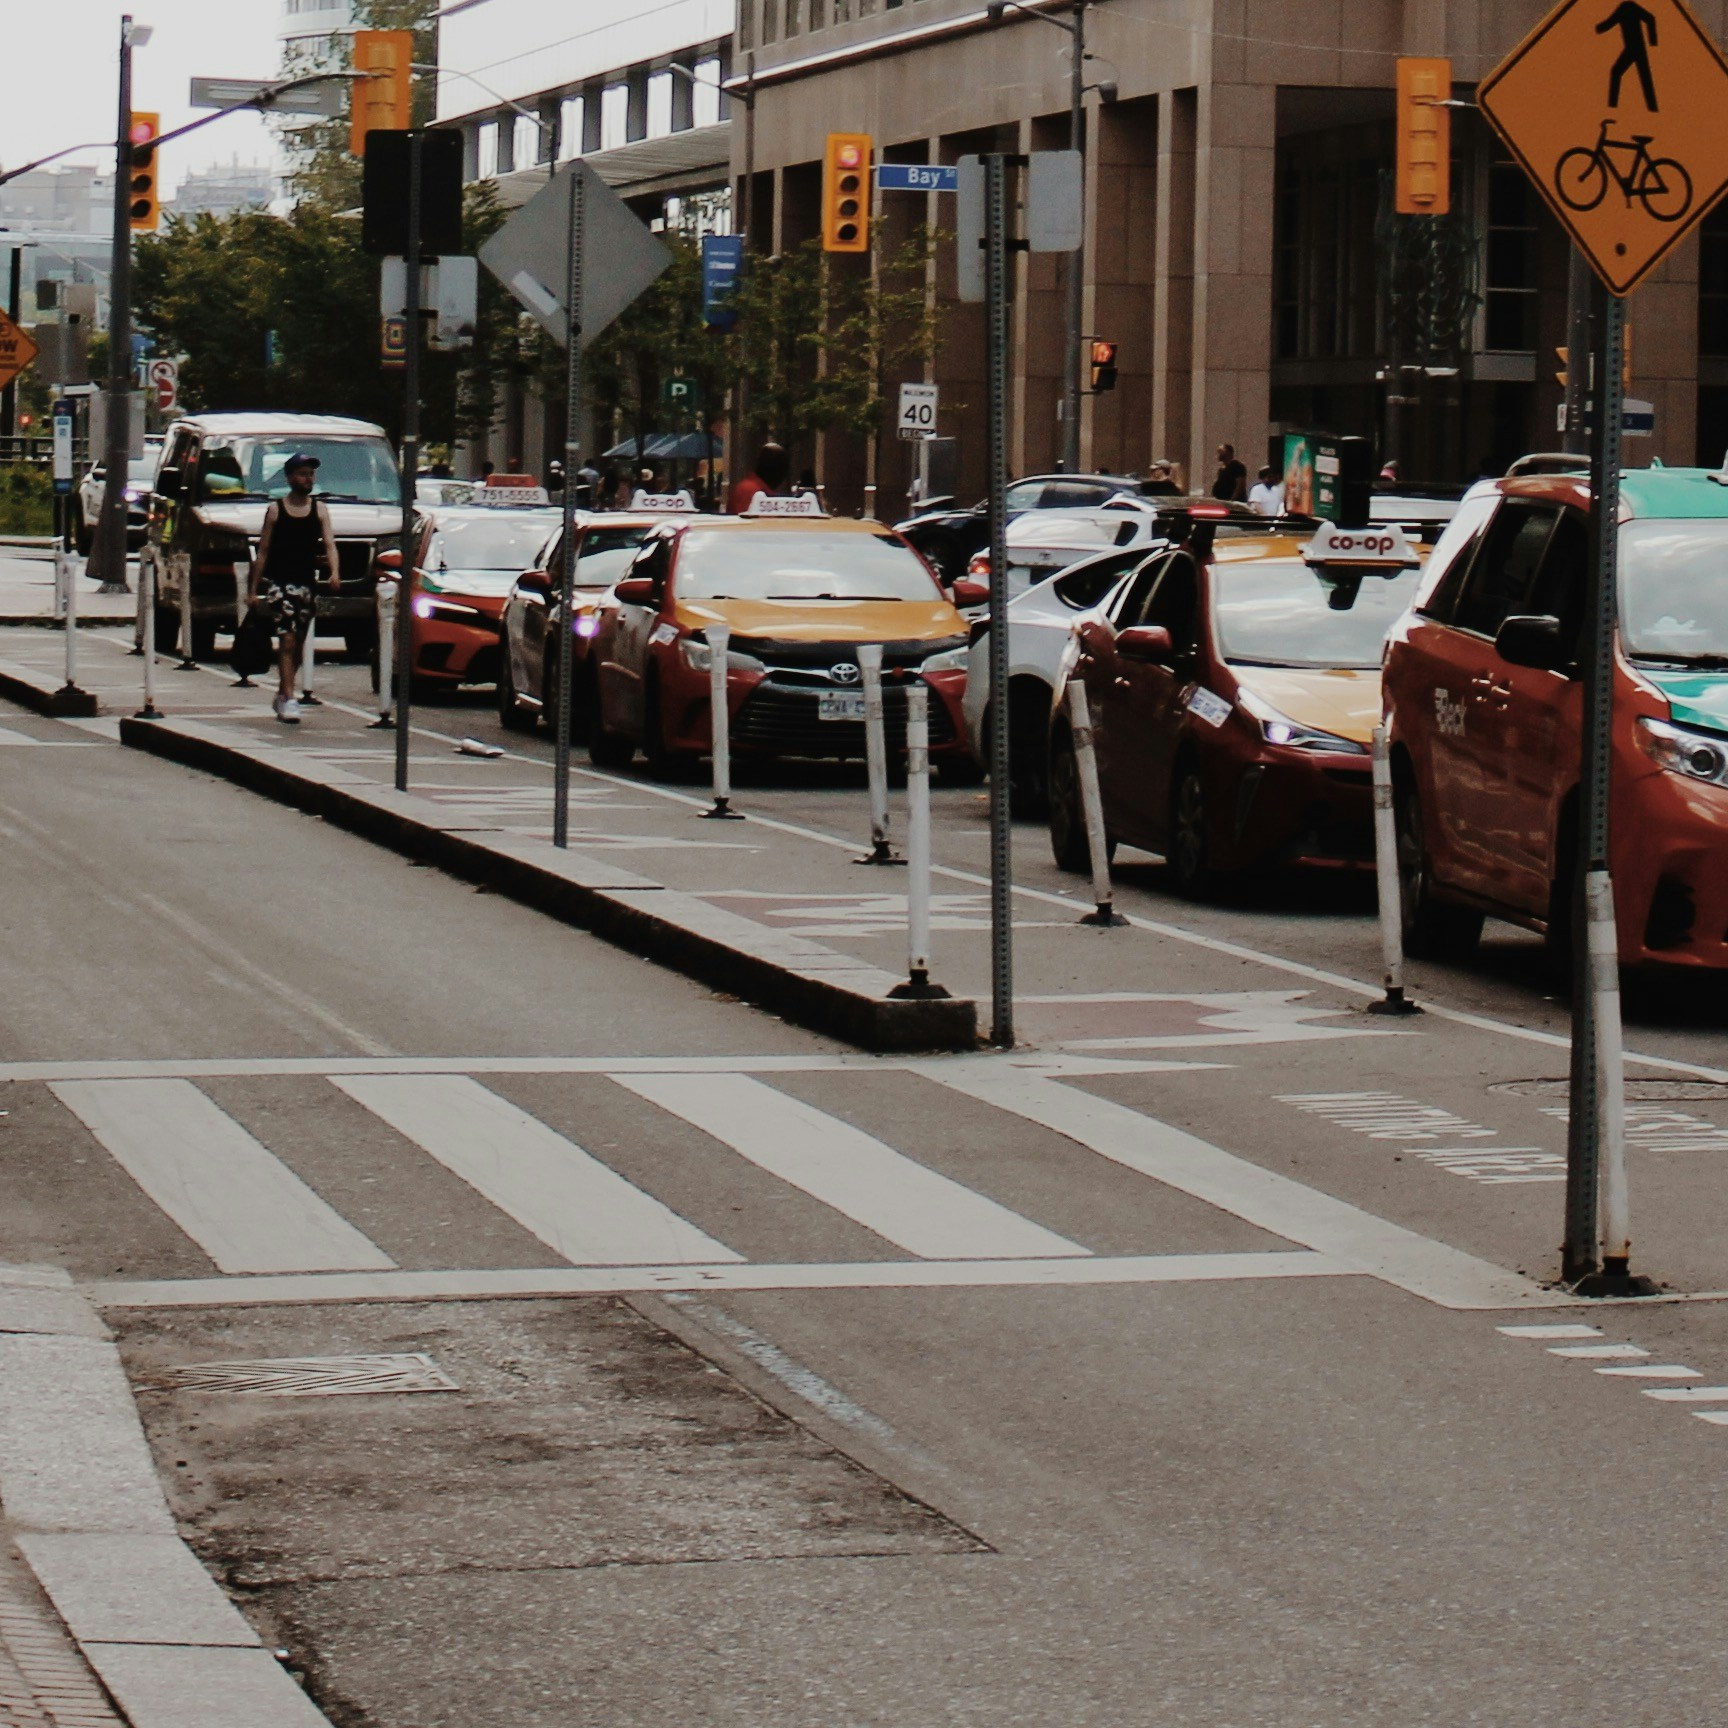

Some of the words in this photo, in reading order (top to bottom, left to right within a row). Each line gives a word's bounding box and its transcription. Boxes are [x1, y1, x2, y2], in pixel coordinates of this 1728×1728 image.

[908, 167, 940, 188] Bay
[904, 404, 932, 424] 40
[481, 489, 540, 501] 751-5555
[642, 497, 685, 509] co-op
[1328, 536, 1395, 556] co-op
